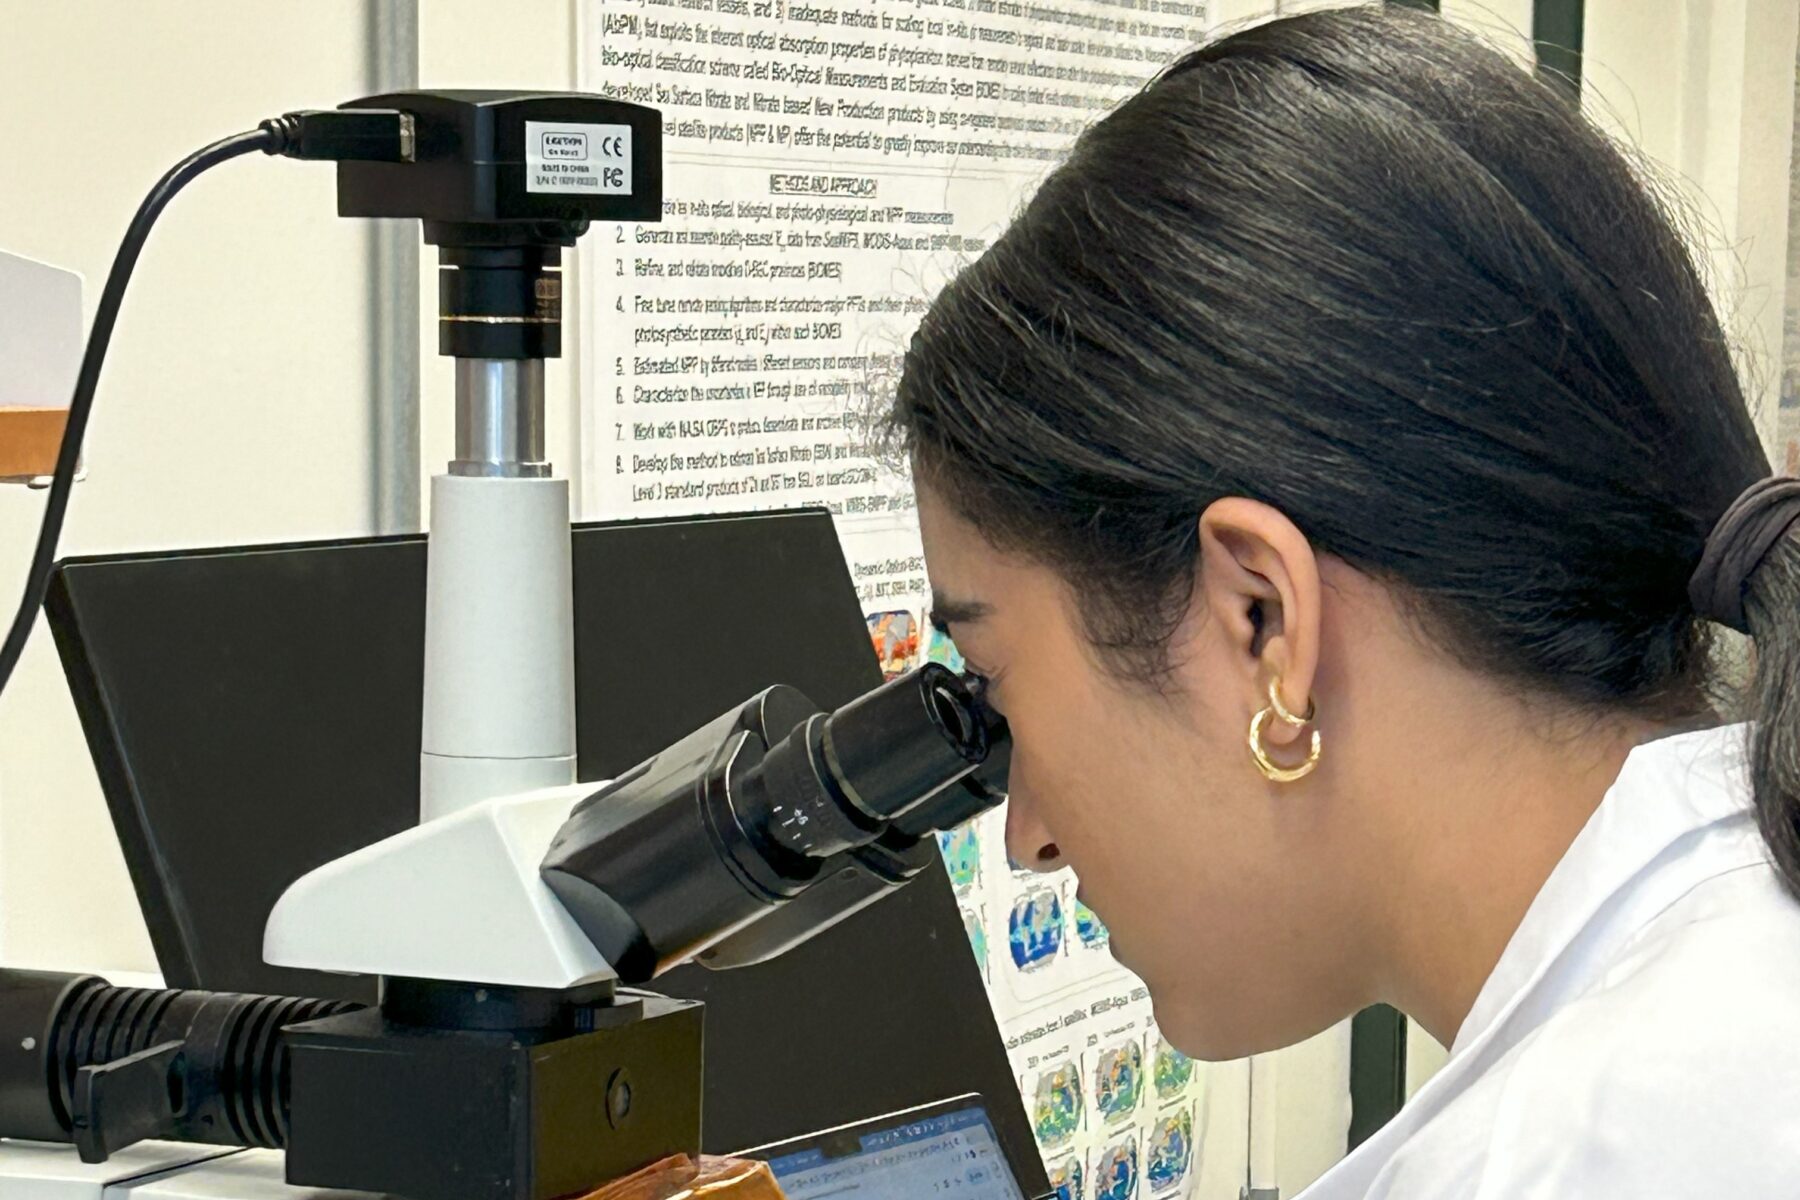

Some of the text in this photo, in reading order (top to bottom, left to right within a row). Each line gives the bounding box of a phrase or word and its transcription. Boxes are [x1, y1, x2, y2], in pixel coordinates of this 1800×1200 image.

[746, 31, 776, 52] optical
[779, 34, 829, 57] absorption
[831, 42, 876, 61] properties
